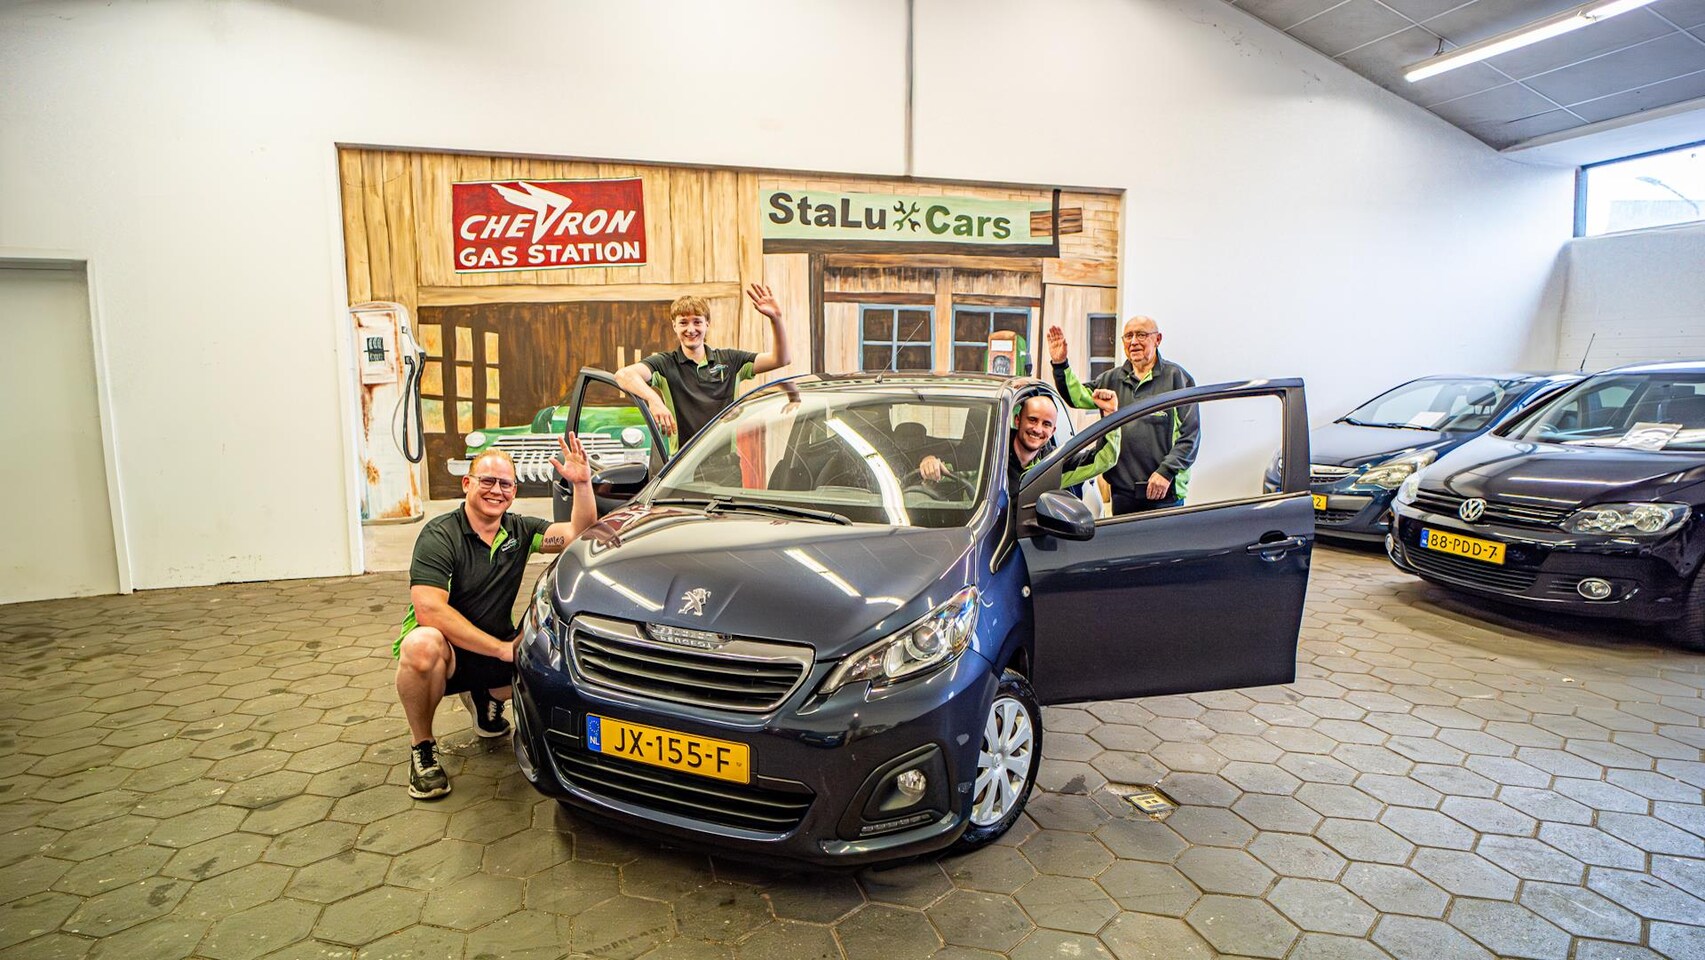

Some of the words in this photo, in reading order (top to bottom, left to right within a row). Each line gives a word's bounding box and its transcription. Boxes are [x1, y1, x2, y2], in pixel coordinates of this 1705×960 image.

[460, 192, 636, 244] CHEVRON
[768, 192, 887, 230] StaLu
[925, 204, 1011, 240] Cars
[459, 246, 519, 268] GAS
[528, 241, 641, 264] STATION
[1430, 533, 1498, 559] 88-PDD-7
[589, 735, 601, 746] NL
[614, 727, 731, 773] JX-155-F
